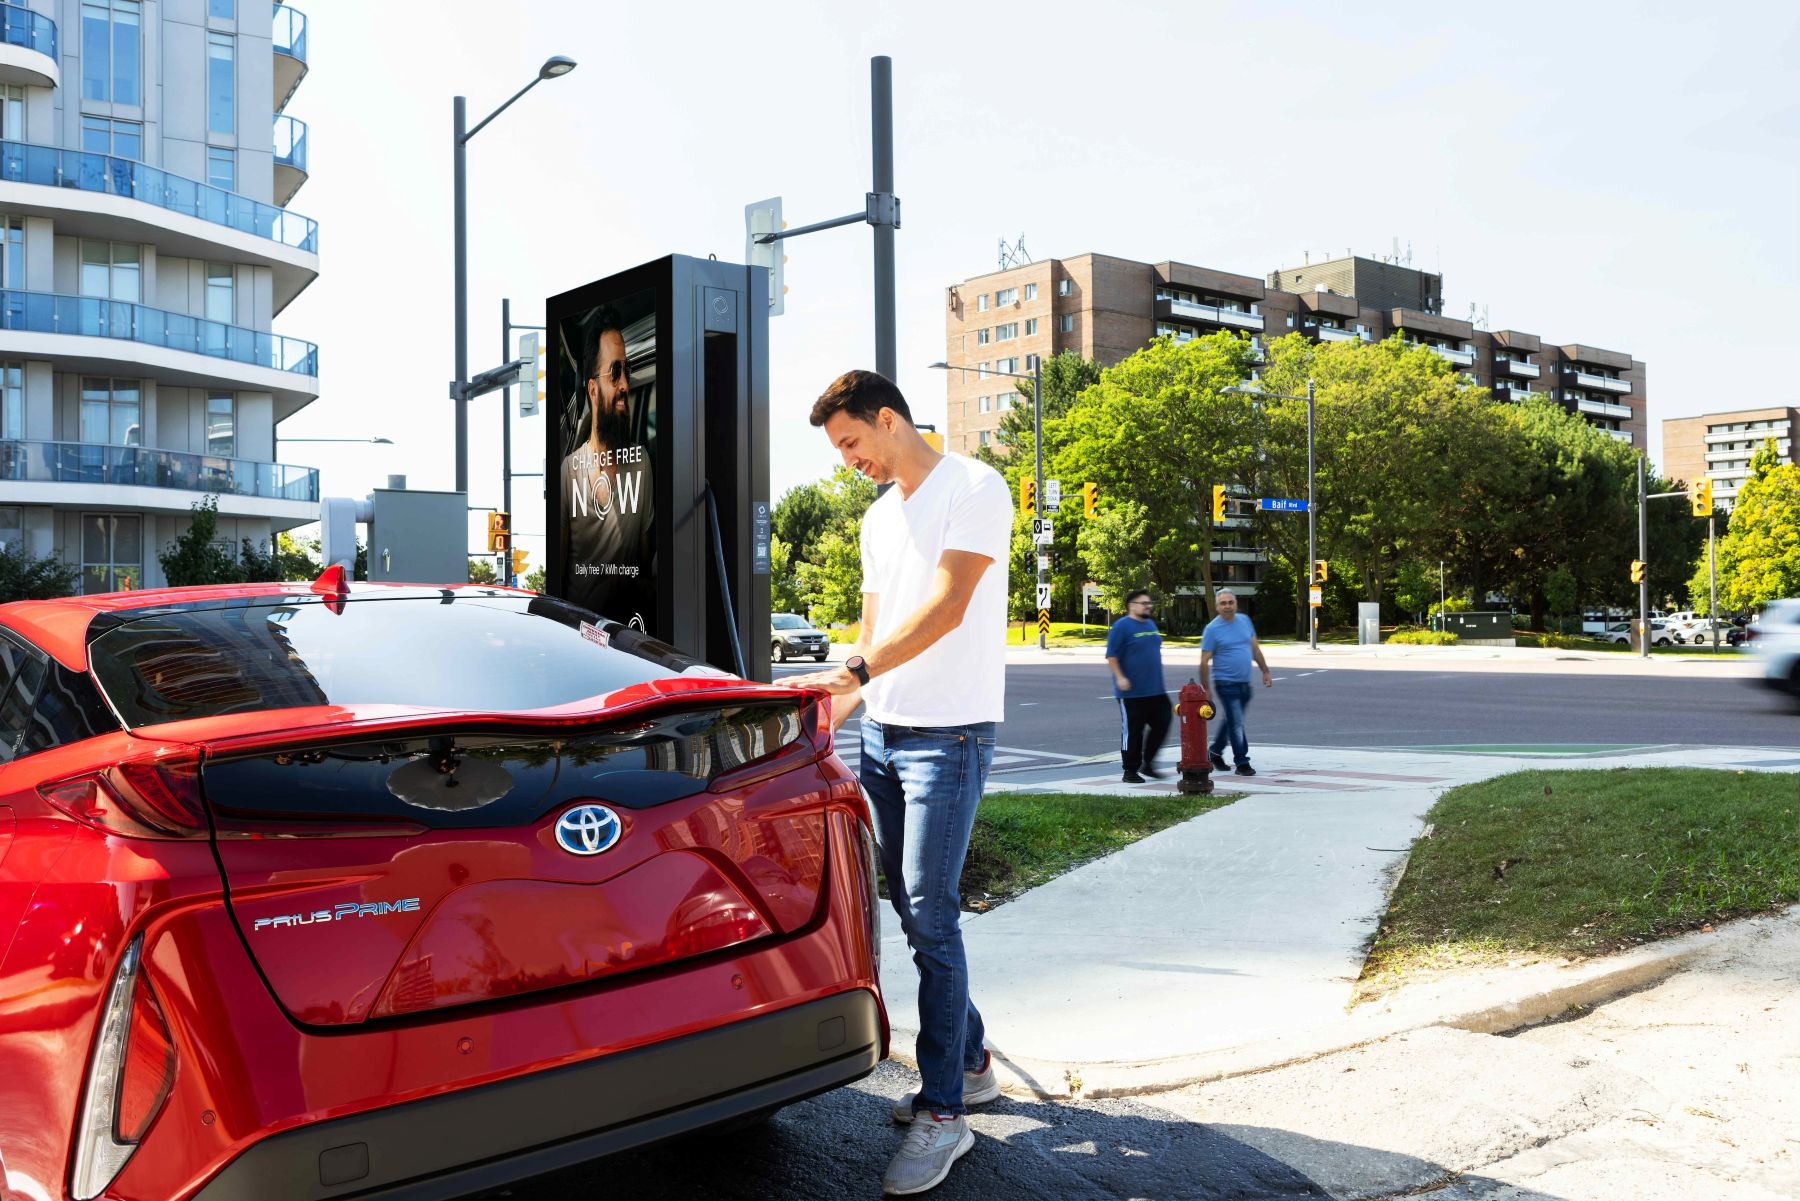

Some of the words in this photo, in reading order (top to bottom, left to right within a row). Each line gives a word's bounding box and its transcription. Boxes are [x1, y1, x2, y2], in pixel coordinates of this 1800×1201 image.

[572, 450, 613, 470] CHARGE
[616, 446, 641, 464] FREE
[572, 471, 642, 520] NOW
[575, 563, 588, 578] Daily
[589, 563, 600, 575] free
[600, 563, 605, 575] 7
[605, 563, 619, 575] kWh
[619, 563, 640, 578] charge
[254, 910, 333, 931] PRIUS
[334, 897, 420, 921] PRIME
